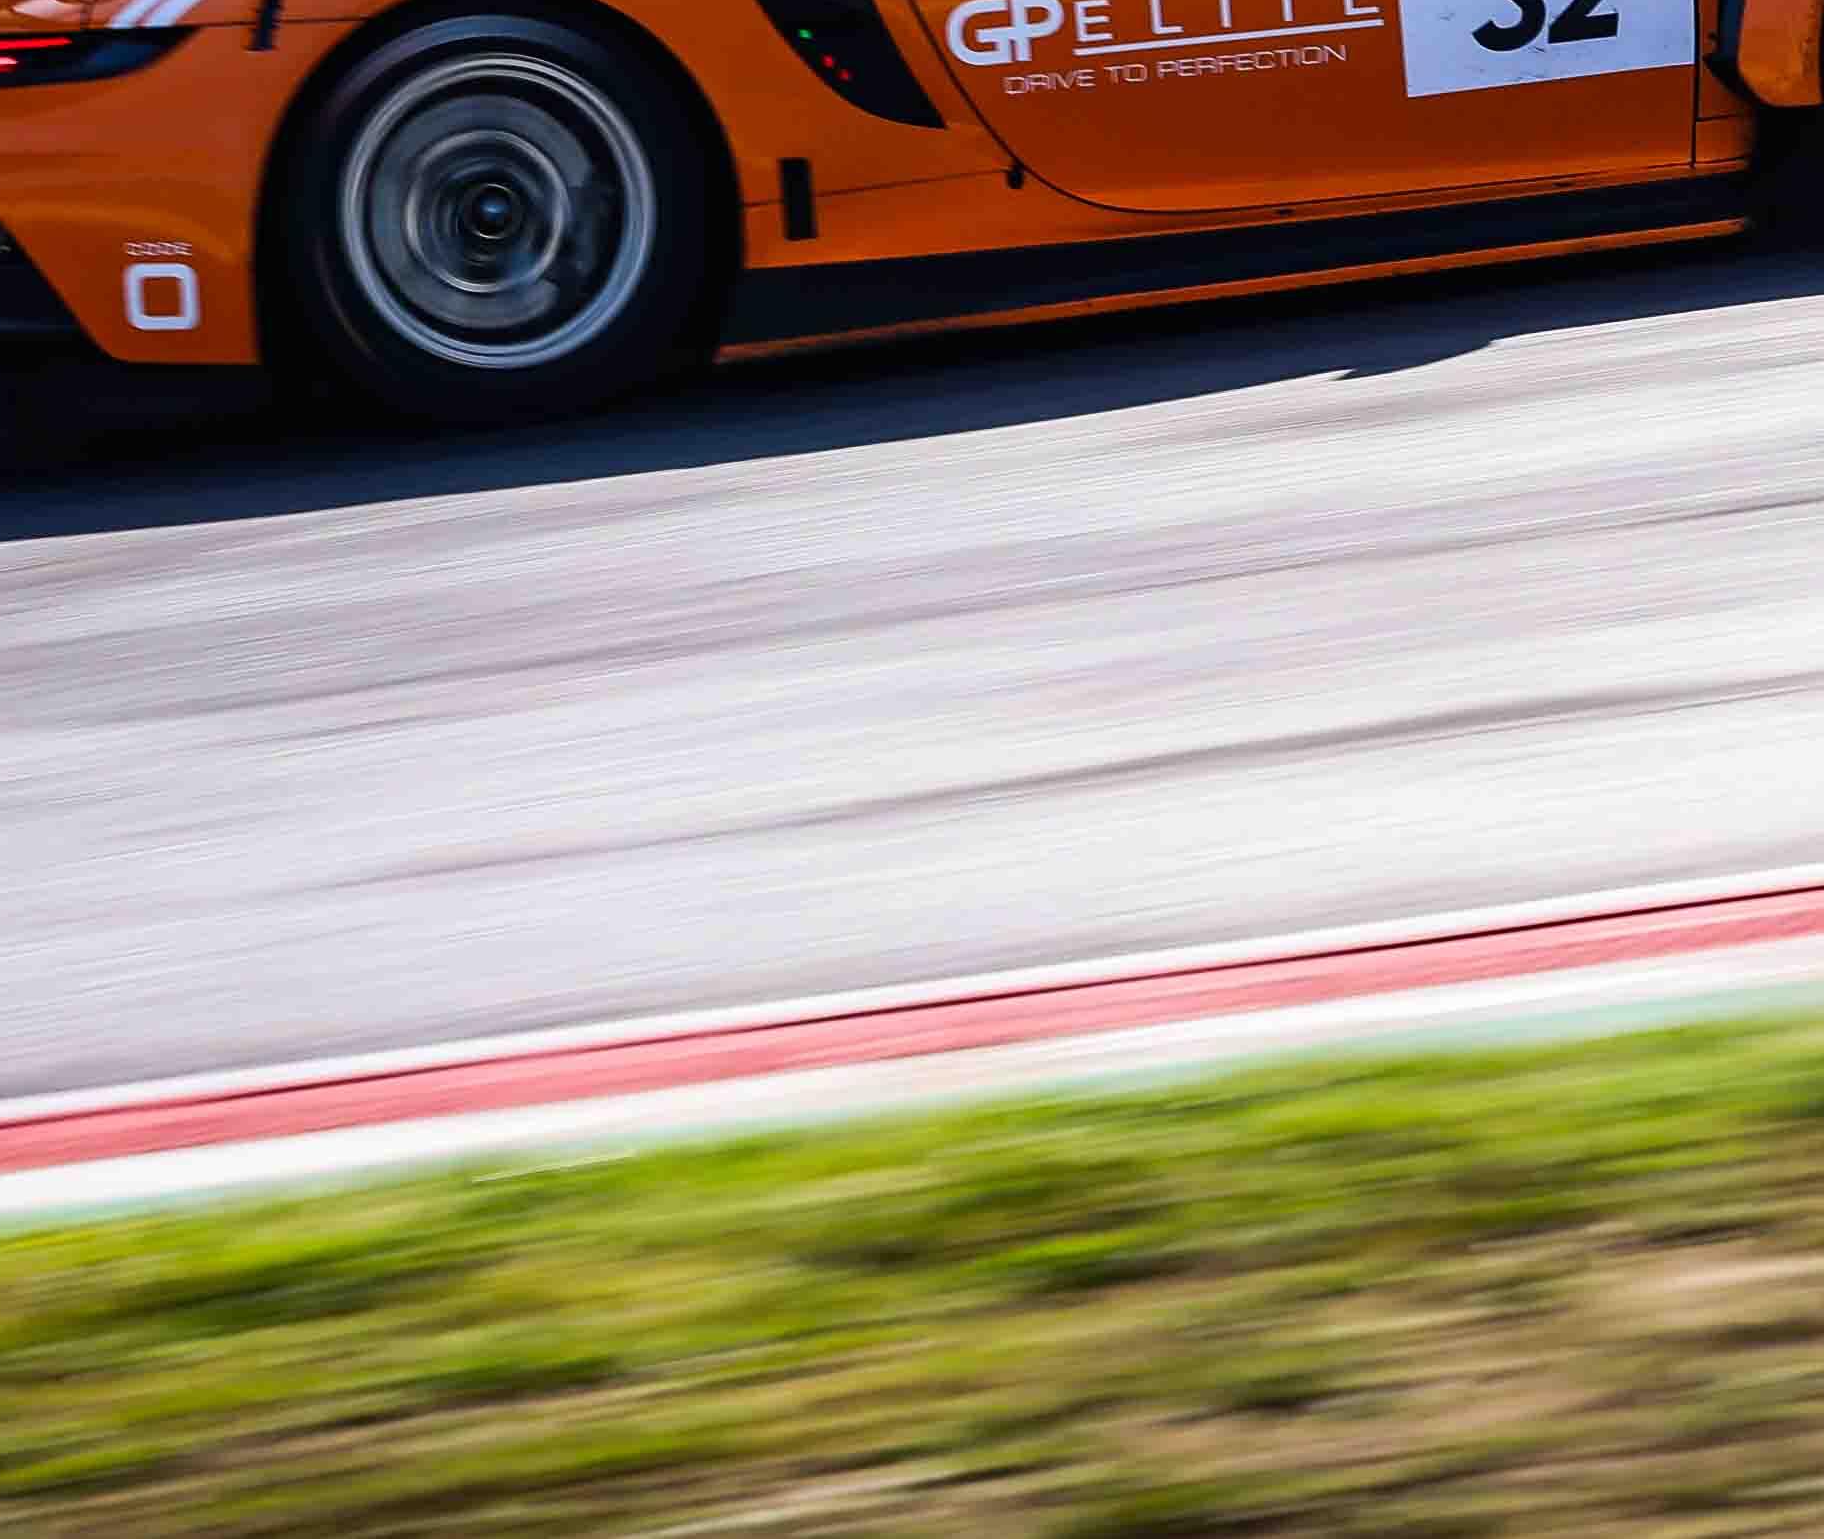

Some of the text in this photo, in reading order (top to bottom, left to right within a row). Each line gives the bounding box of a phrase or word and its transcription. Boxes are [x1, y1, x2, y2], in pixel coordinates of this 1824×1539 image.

[1004, 45, 1348, 95] DRIVE TO PERFECTION
